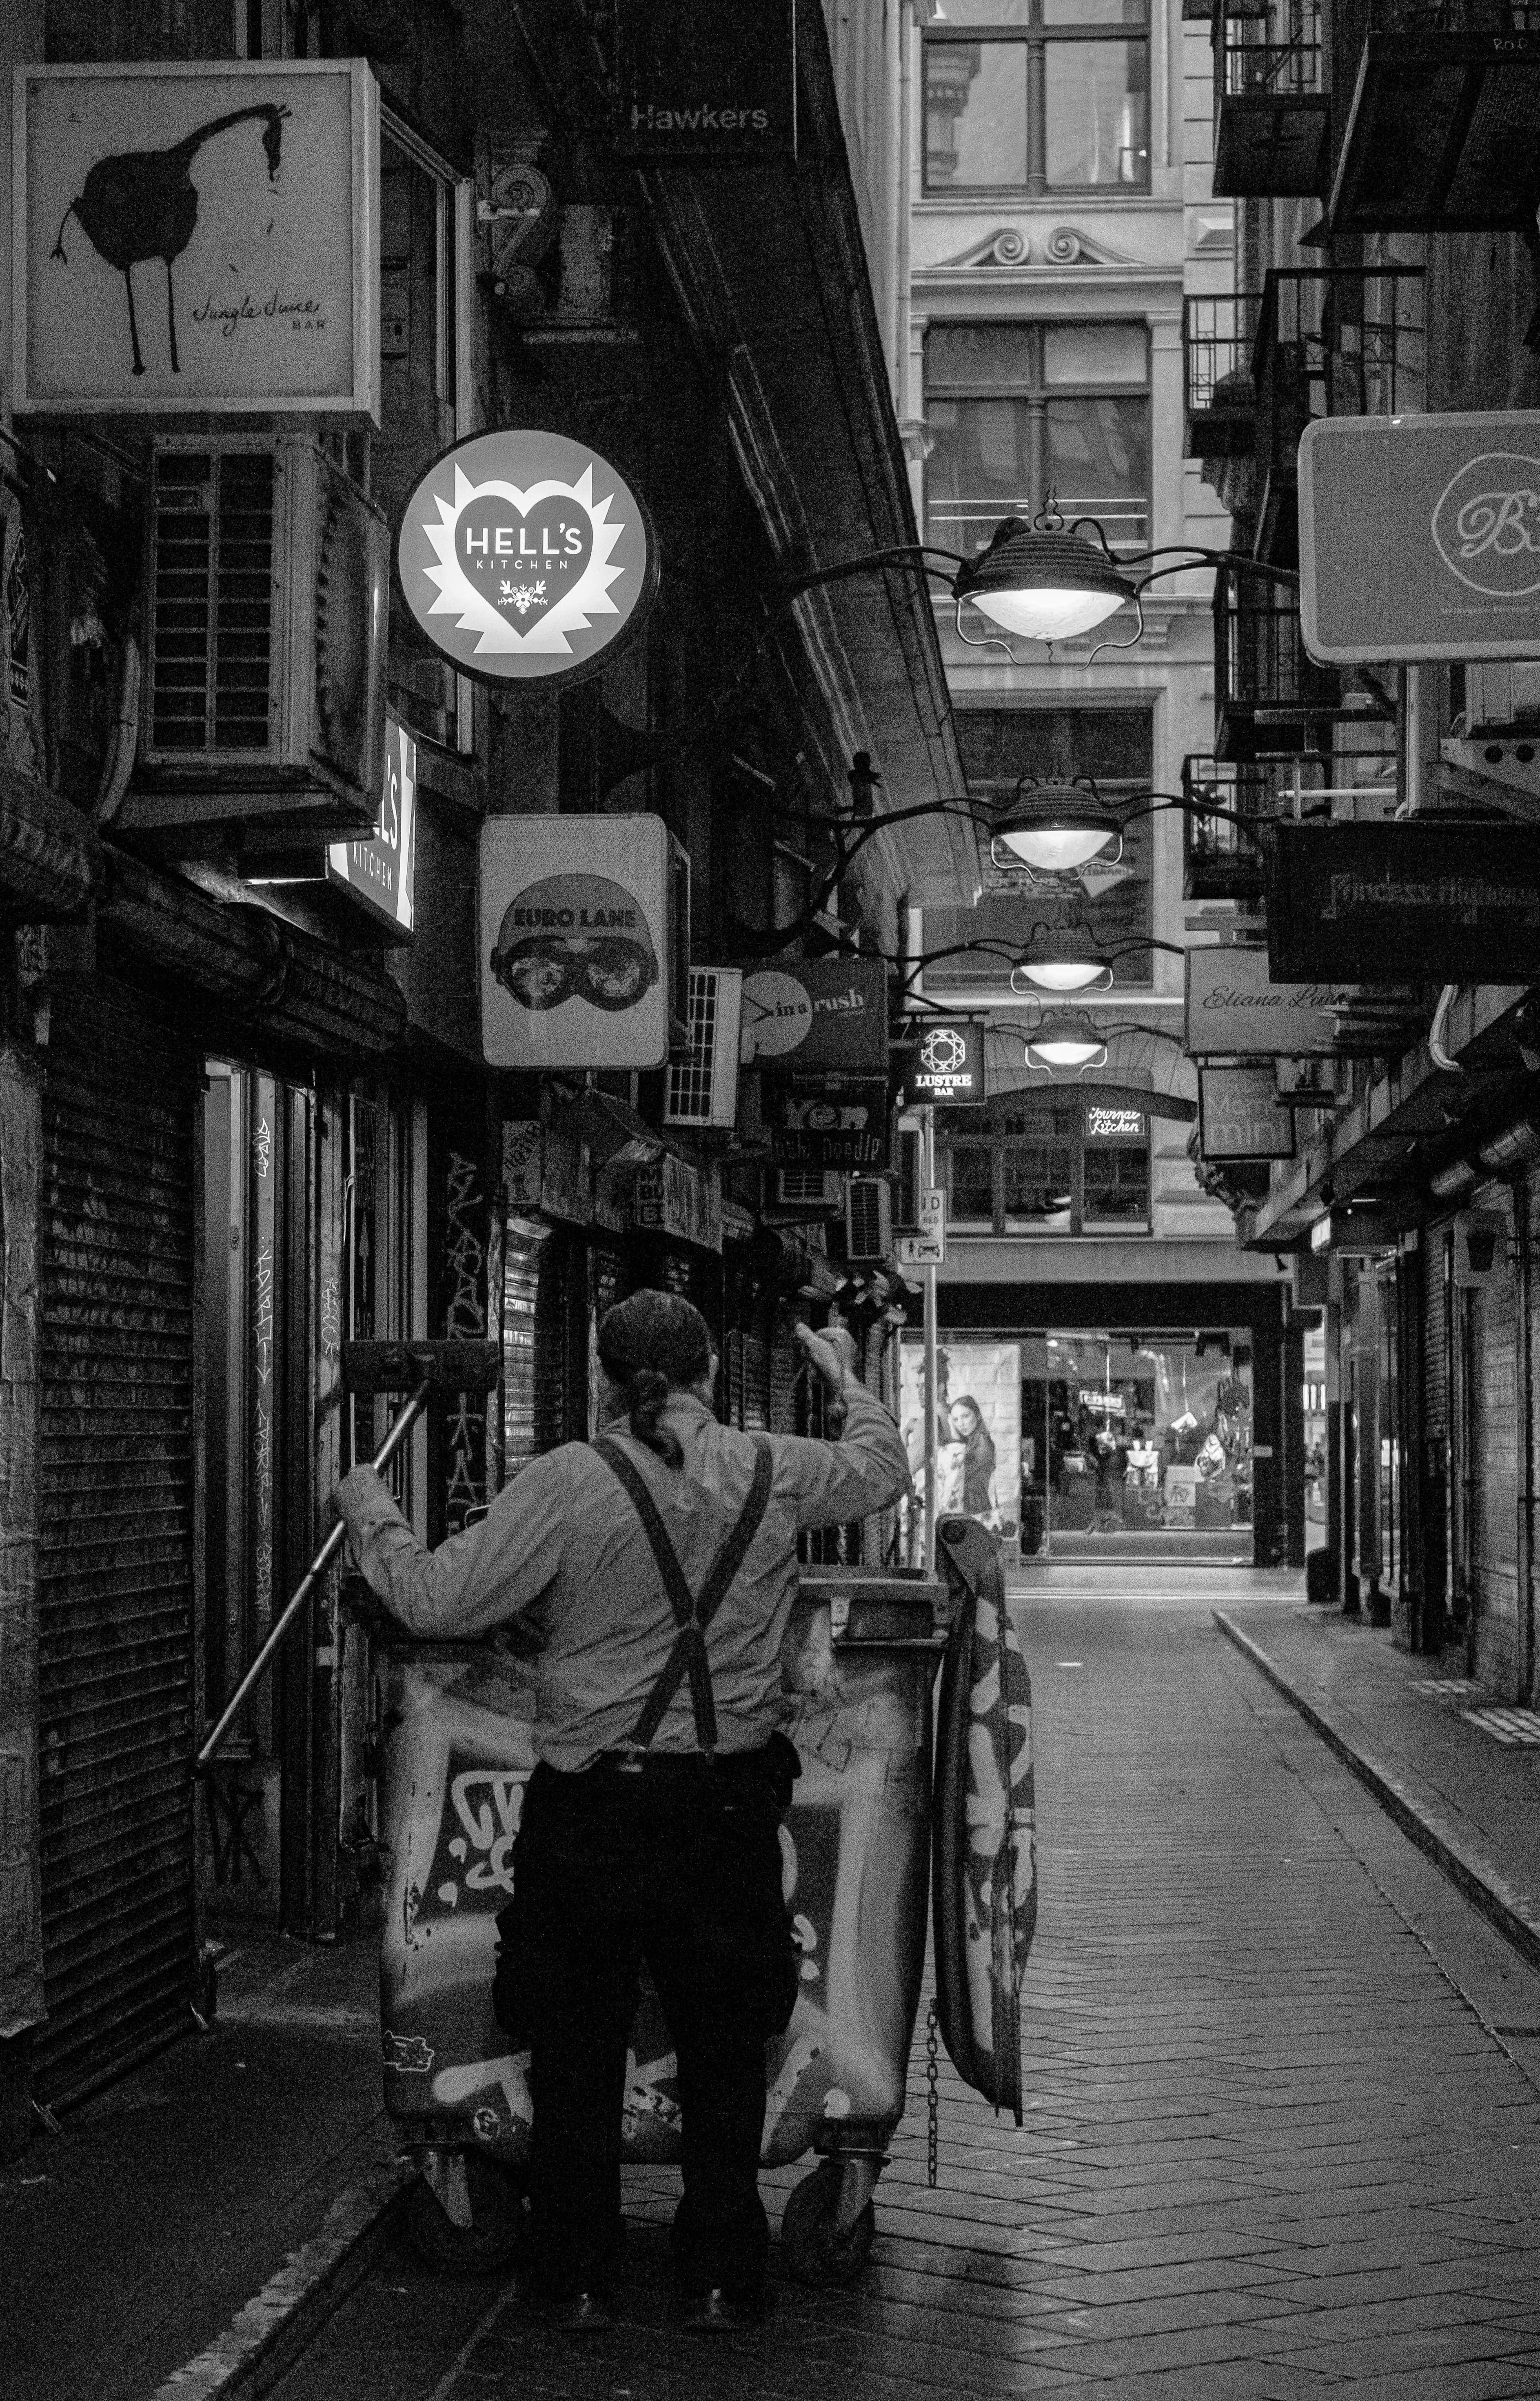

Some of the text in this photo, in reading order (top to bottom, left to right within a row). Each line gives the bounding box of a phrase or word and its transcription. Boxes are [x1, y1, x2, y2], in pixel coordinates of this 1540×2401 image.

[631, 103, 770, 130] Hawkers
[192, 289, 321, 337] Jungle Juice
[292, 320, 325, 330] BAR
[466, 522, 583, 555] HELL'S
[476, 560, 568, 570] KITCHEN
[353, 841, 393, 891] KITCHEN
[1320, 873, 1431, 920] Princess
[514, 908, 637, 928] EURO LANE
[776, 1001, 795, 1017] in
[797, 1002, 808, 1014] a
[813, 988, 865, 1013] rush
[1203, 985, 1285, 1009] Eliana
[915, 1074, 972, 1087] LUSTRE
[934, 1087, 954, 1096] BAR
[783, 1098, 869, 1130] Yen
[1091, 1118, 1140, 1135] Kitchen
